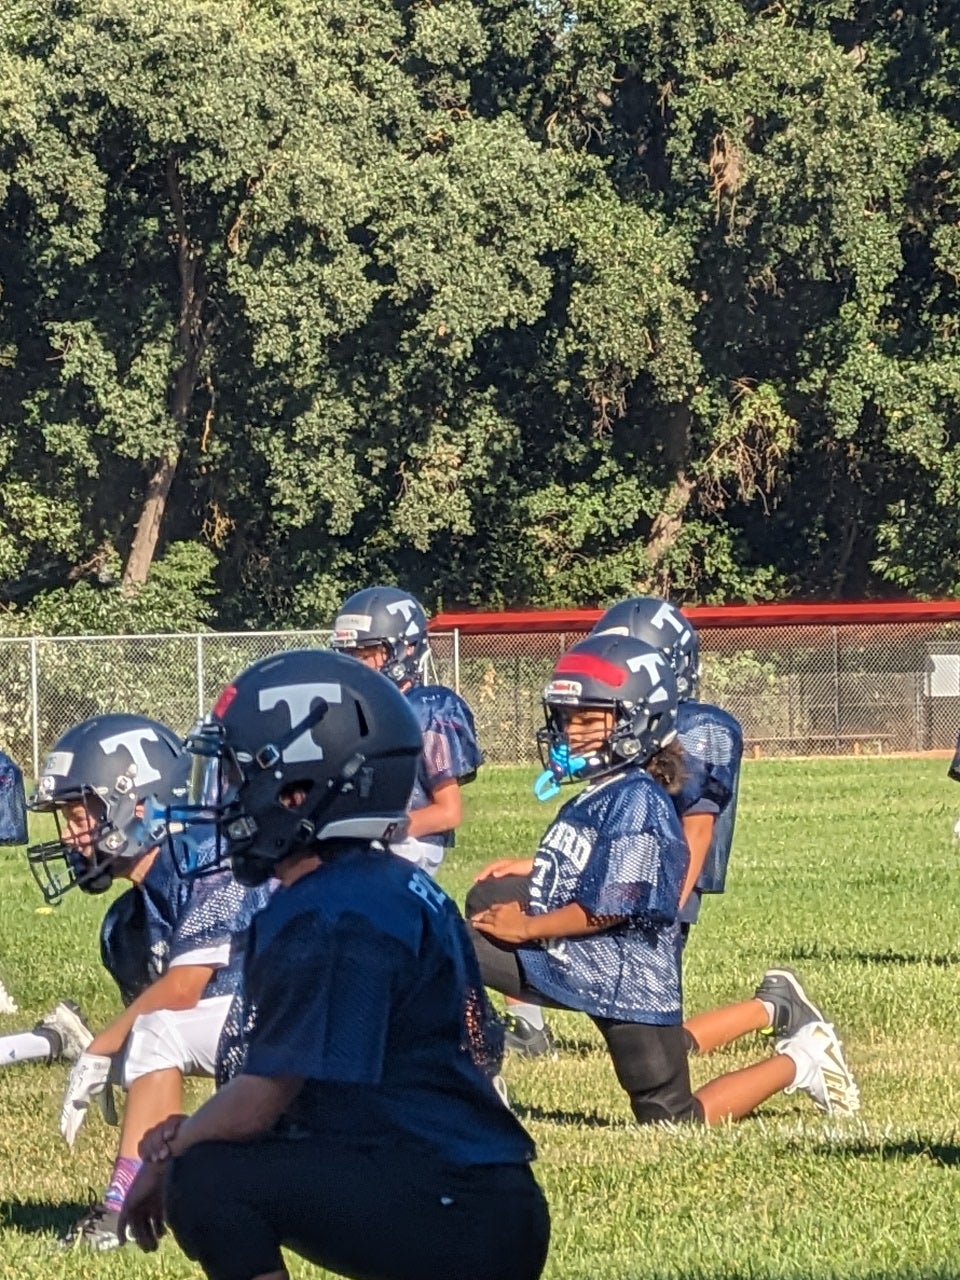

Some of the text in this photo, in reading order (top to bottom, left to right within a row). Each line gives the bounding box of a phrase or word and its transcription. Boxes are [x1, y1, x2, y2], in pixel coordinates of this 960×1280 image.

[385, 599, 417, 636] T
[650, 602, 691, 645] T
[626, 653, 665, 703] T
[259, 682, 342, 763] T
[99, 728, 161, 787] T
